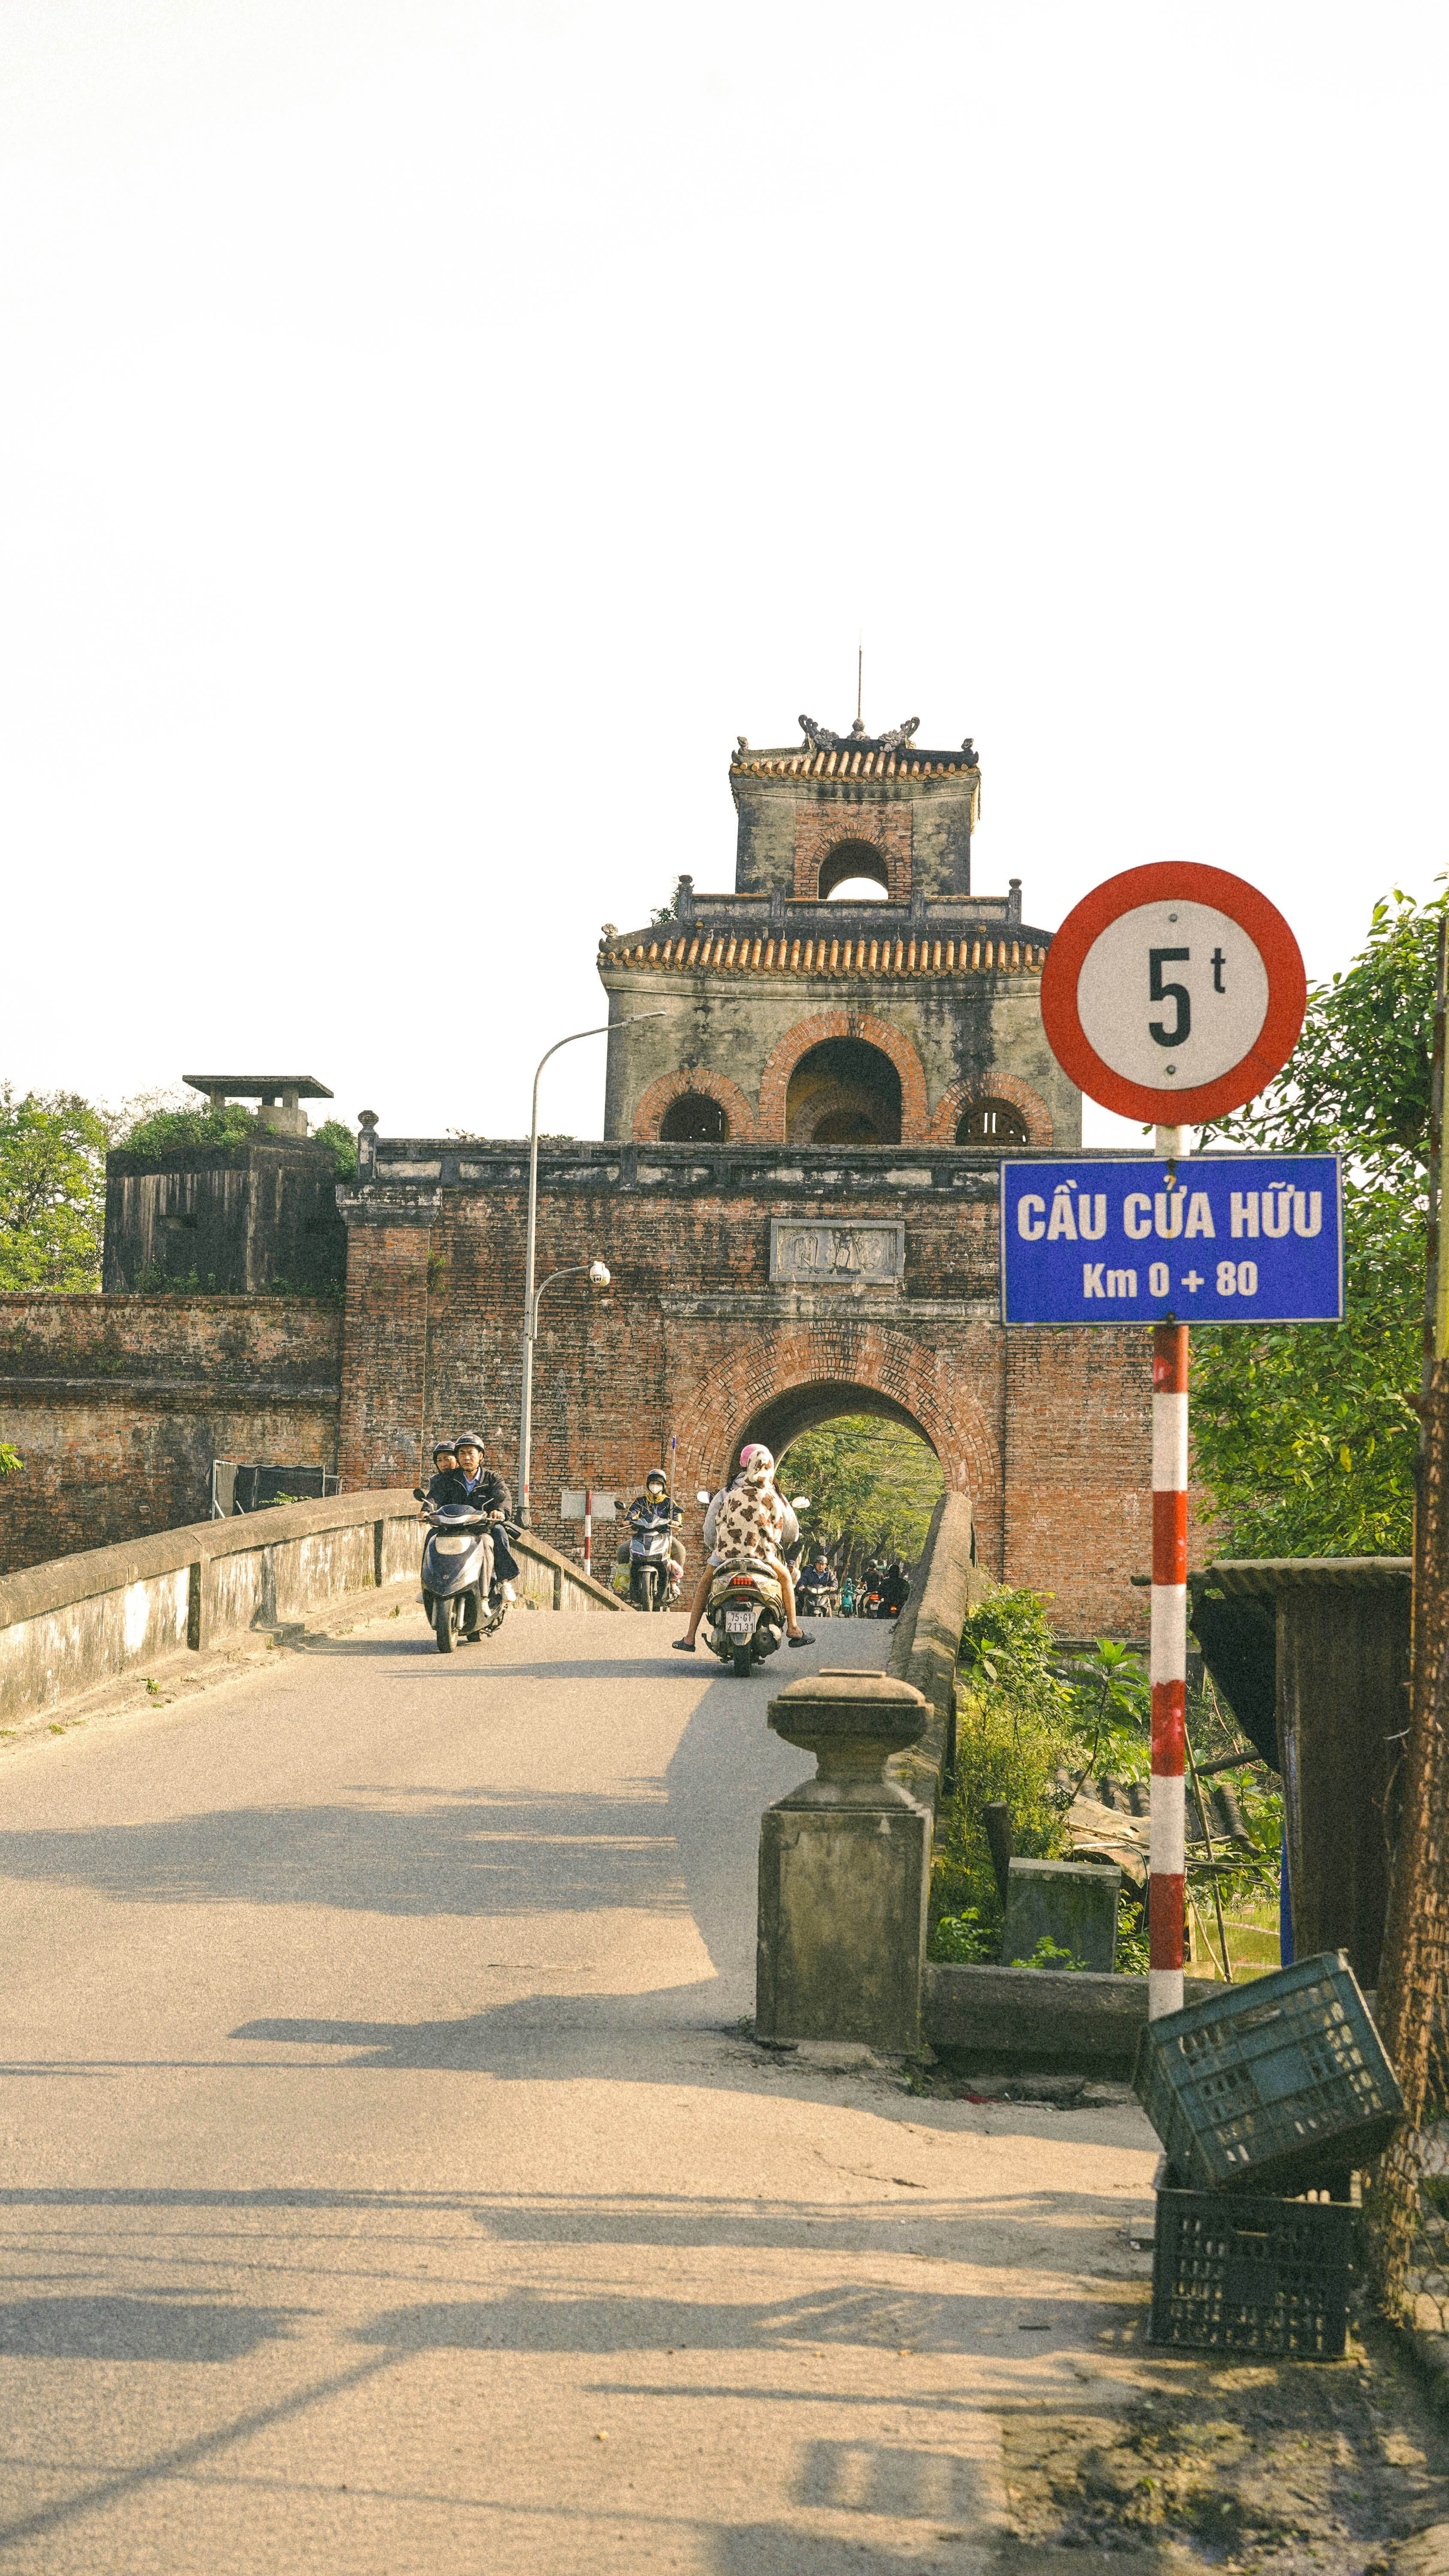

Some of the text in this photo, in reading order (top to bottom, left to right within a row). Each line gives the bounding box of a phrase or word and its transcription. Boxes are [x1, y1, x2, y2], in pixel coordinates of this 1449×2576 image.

[1017, 1174, 1322, 1241] CẦU CỬA HỮU
[1082, 1263, 1138, 1298] Km
[1148, 1261, 1170, 1298] 0
[1216, 1260, 1259, 1297] 80
[728, 1622, 754, 1631] 211.31
